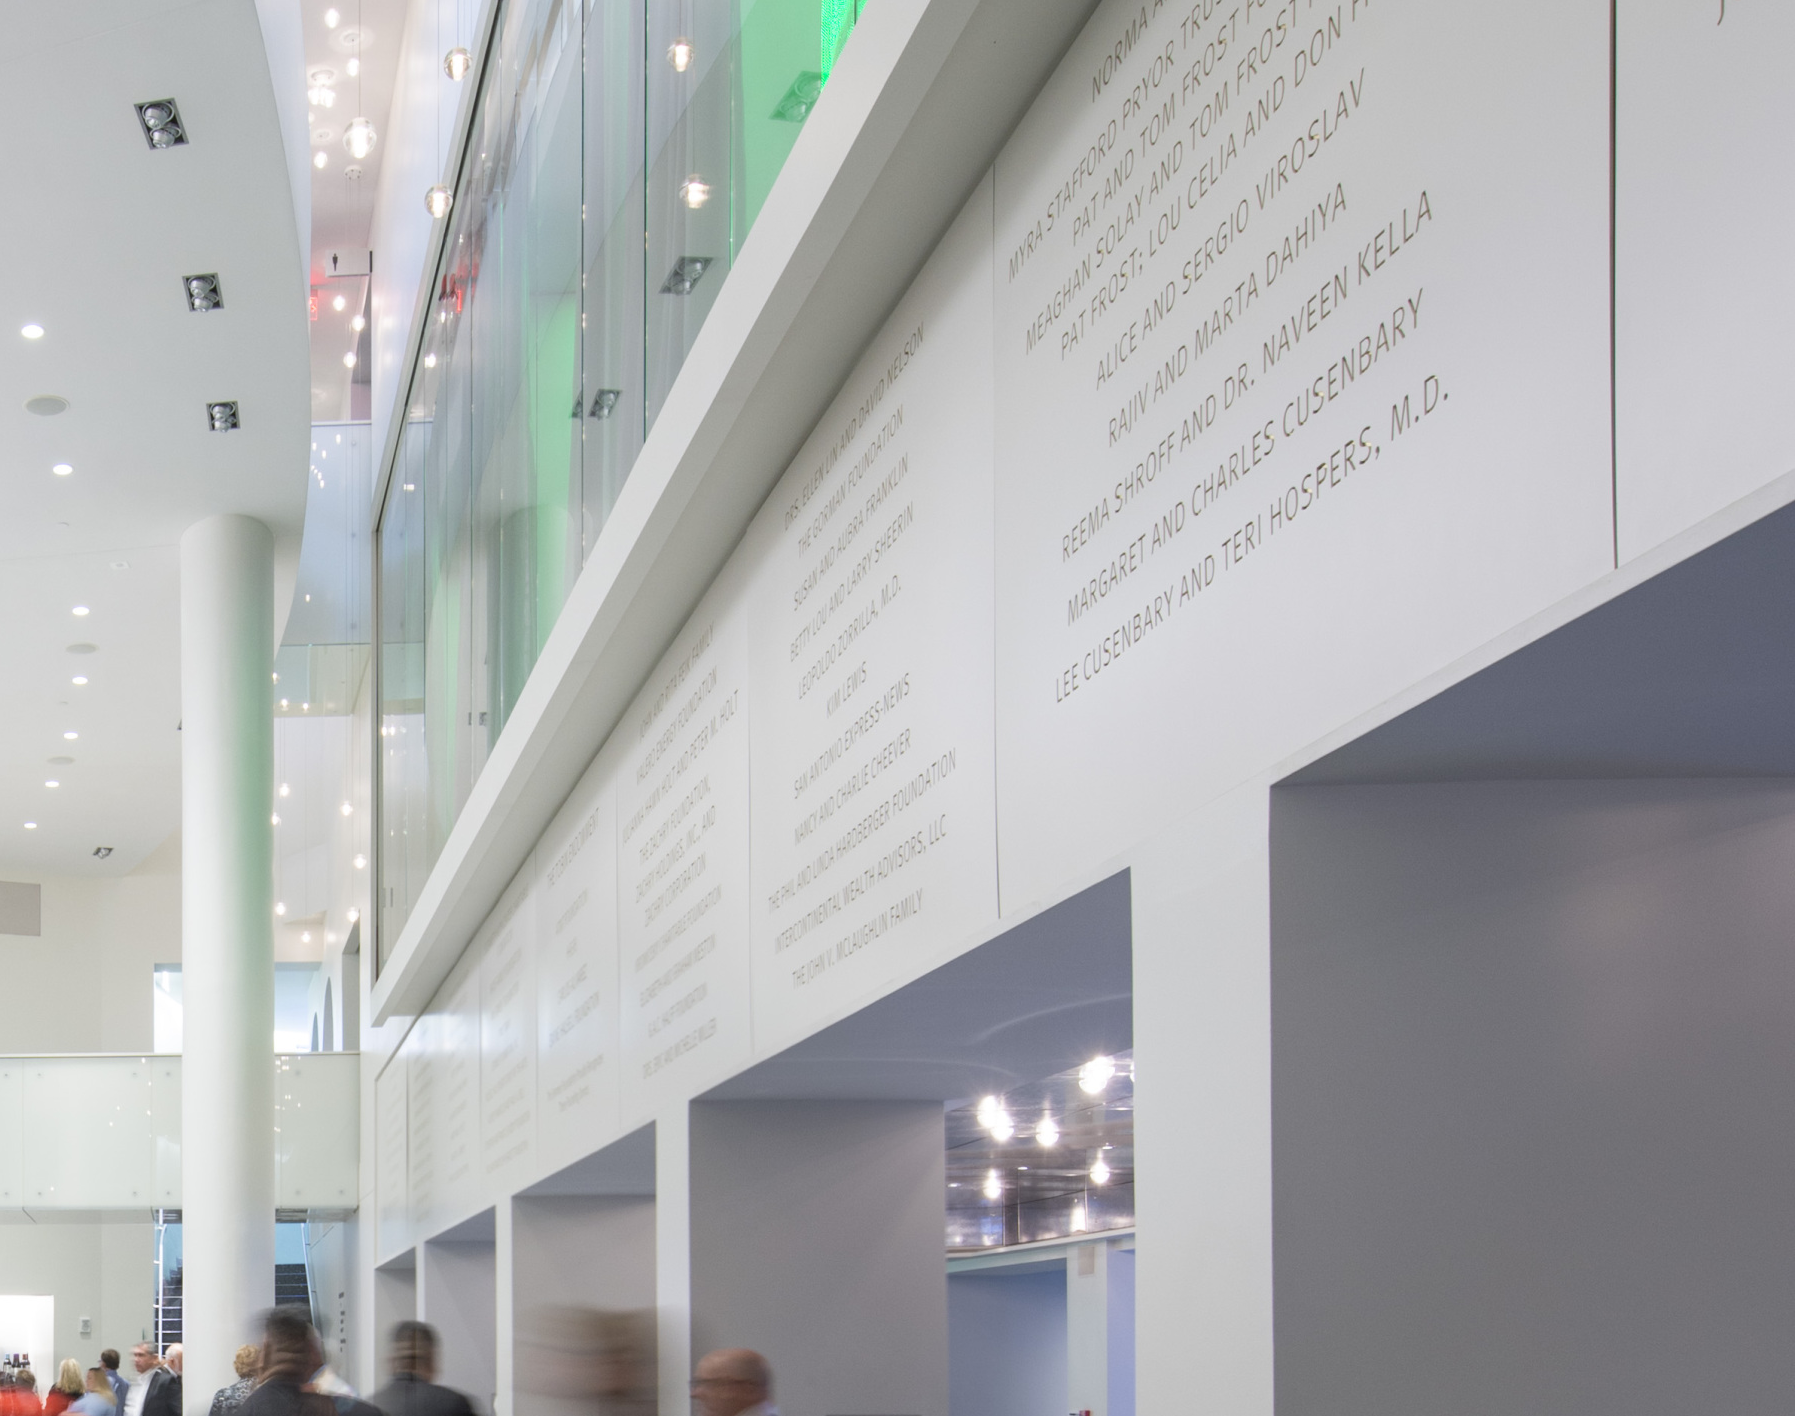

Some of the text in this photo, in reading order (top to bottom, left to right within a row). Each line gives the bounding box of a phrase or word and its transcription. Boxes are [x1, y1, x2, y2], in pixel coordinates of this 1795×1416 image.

[1072, 190, 1099, 247] PAT
[1102, 147, 1134, 209] AND
[1139, 90, 1175, 158] TOM
[1181, 5, 1239, 107] FROST
[1091, 4, 1148, 103] NORMA
[1008, 219, 1043, 284] MYRA
[1046, 117, 1117, 232] STAFFORD
[1122, 38, 1174, 131] PRYOR
[1025, 252, 1091, 356] MEAGHAN
[1095, 184, 1144, 269] SOLAY
[1148, 139, 1183, 205] AND
[1188, 79, 1229, 151] TOM
[1060, 307, 1086, 361] PAT
[1090, 245, 1143, 327] FROST;
[1148, 194, 1181, 259] LOU
[1186, 131, 1237, 210] CELIA
[1242, 73, 1285, 149] AND
[1293, 3, 1341, 89] DON
[1095, 65, 1365, 391] ALICE AND SERGIO VIROSLAV
[1061, 188, 1433, 563] REEMA SHROFF AND DR. NAVEEN KELLA
[1108, 180, 1347, 448] RAJIV AND MARTA DAHIYA
[784, 322, 924, 531] DRS. ELLEN LIN AND DAVID NELSON
[797, 404, 903, 557] THE GORMAN FOUNDATION
[1067, 285, 1423, 627] MARGARET AND CHARLES CUSENBARY
[790, 501, 913, 662] BETTY LOU AND LARRY SHEERIN
[793, 452, 908, 611] SUSAN AND AUBRA FRANKLIN
[1055, 372, 1449, 704] LEE CUSENBARY AND TERI HOSPERS, M.D.
[798, 574, 901, 700] LEOPOLDO ZORRILLA, M.D.
[826, 661, 867, 718] KIM LEWIS
[793, 672, 910, 800] SAN ANTONIO EXPRESS-NEWS
[794, 728, 911, 846] NANCY AND CHARLIE CHEEVER
[767, 748, 956, 909] THE PHIL AND LINDA HARDBERGER FOUNDATION
[776, 813, 947, 953] INTERCONTINENTAL WEALTH ADVISORS, LLC
[791, 888, 923, 985] THE JOHN V. MCLAUGHLIN FAMILY
